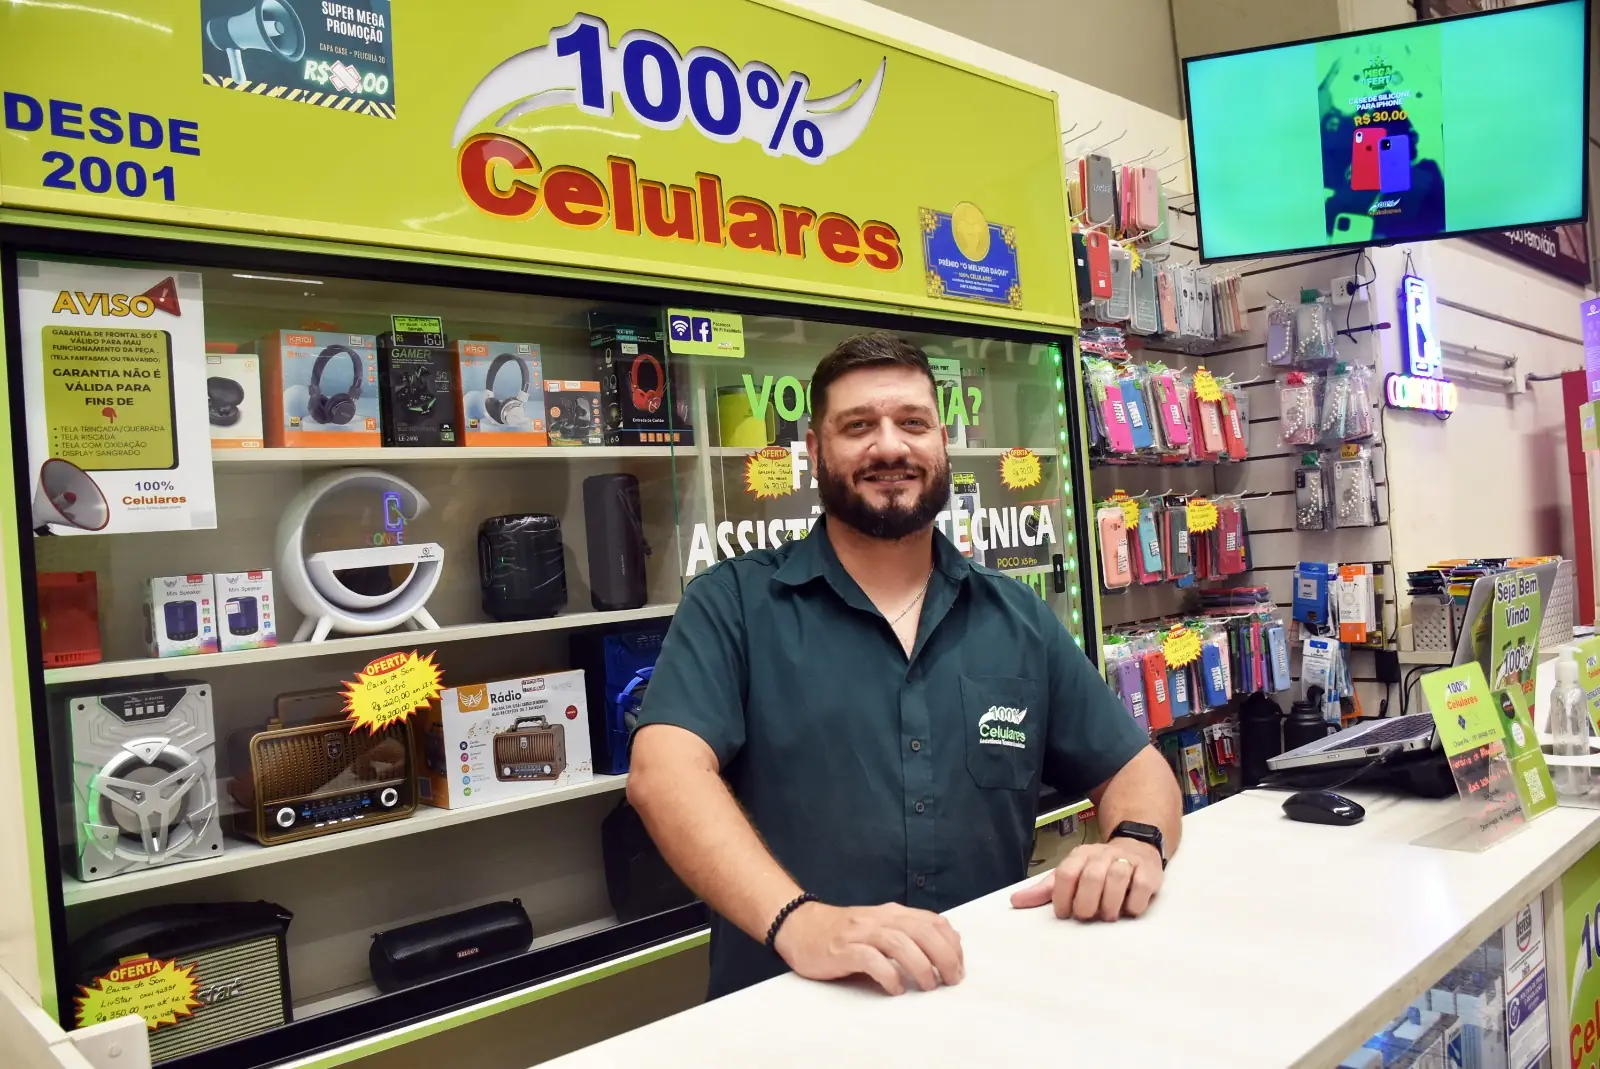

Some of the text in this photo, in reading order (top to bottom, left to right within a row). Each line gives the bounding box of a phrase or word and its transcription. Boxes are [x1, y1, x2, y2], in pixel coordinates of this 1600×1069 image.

[322, 1, 385, 28] SUPER MEGA
[326, 18, 382, 44] PROMOÇÃO
[556, 22, 824, 159] 100%
[1356, 102, 1376, 111] PARA
[4, 91, 200, 156] DESDE
[1354, 110, 1408, 126] R$ 30,00
[42, 150, 175, 201] 2001
[459, 136, 903, 272] Celulares
[968, 264, 990, 274] MELHOR
[52, 290, 156, 318] AVISO
[70, 337, 100, 345] VÁLIDO
[424, 334, 441, 346] 160
[52, 344, 120, 352] FUNCIONAMENTO
[392, 348, 432, 358] GAMER
[52, 368, 161, 379] GARANTIA NÃO É
[66, 382, 151, 392] VÁLIDA PARA
[85, 397, 134, 406] FINS DE
[742, 374, 812, 422] VO
[104, 442, 147, 450] OXIDAÇÃO
[762, 450, 787, 458] OFERTA
[134, 481, 174, 492] 100%
[122, 496, 186, 506] Celulares
[997, 556, 1038, 568] POCO X5 Pro
[1497, 577, 1537, 604] Seja Bem
[1506, 605, 1530, 627] Vindo
[366, 653, 408, 676] OFERTA
[1504, 646, 1529, 675] 100%
[366, 679, 388, 691] Caixa
[1446, 680, 1468, 694] 100%
[490, 690, 522, 704] Rádio
[1446, 696, 1478, 710] Celulares
[988, 706, 1021, 725] 100%
[980, 724, 1026, 742] Celulares
[110, 960, 162, 982] OFERTA
[149, 976, 166, 986] Som
